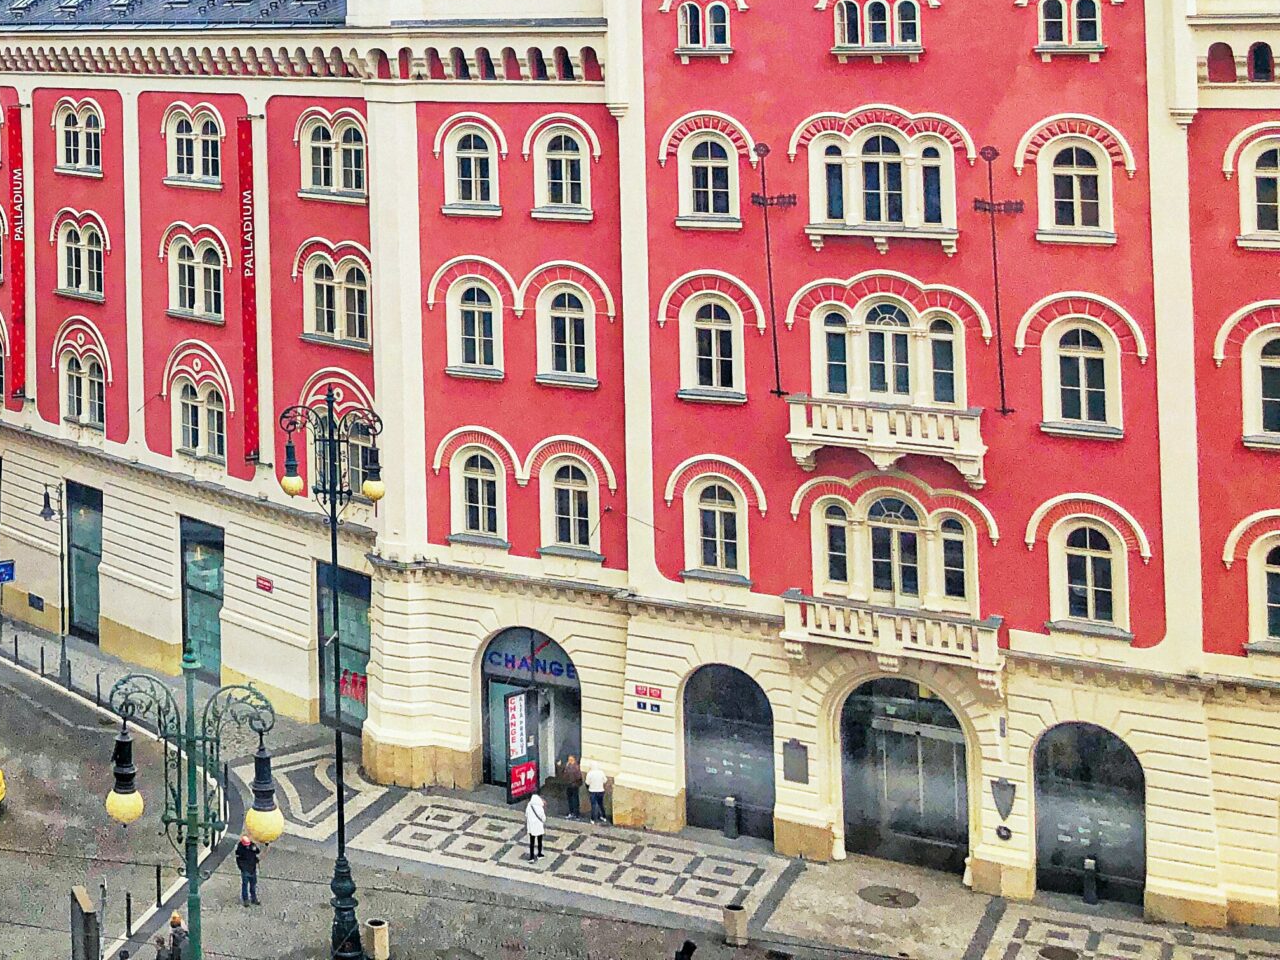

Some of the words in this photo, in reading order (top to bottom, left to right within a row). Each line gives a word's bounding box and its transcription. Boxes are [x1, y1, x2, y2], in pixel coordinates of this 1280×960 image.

[13, 168, 24, 241] PALLADIUM
[242, 190, 254, 278] PALLADIUM
[488, 652, 575, 679] CHANGE
[509, 697, 517, 744] CHANGE
